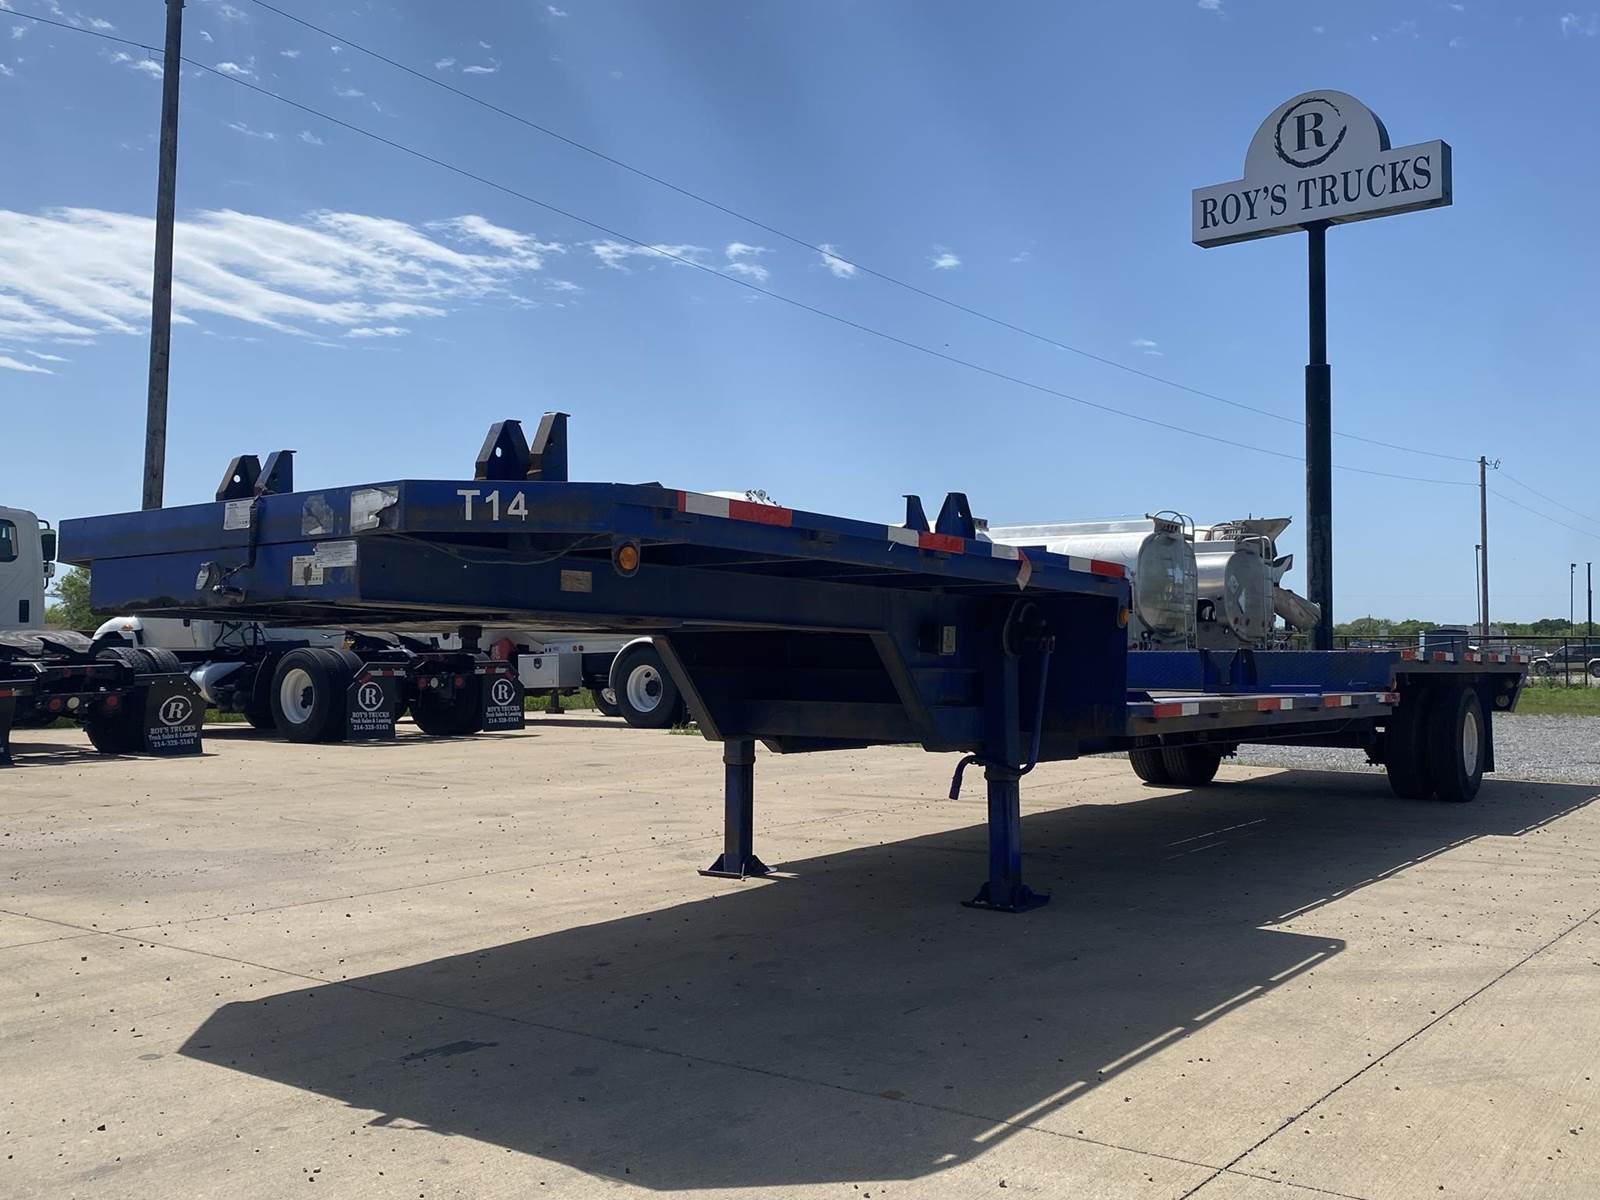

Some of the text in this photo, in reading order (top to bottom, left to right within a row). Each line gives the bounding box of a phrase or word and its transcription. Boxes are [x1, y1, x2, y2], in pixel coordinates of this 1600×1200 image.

[1293, 112, 1328, 152] R
[1200, 155, 1432, 230] ROY'S TRUCKS
[456, 489, 529, 522] T14
[364, 687, 377, 705] R
[167, 702, 184, 719] R
[170, 724, 196, 733] TRUCKS
